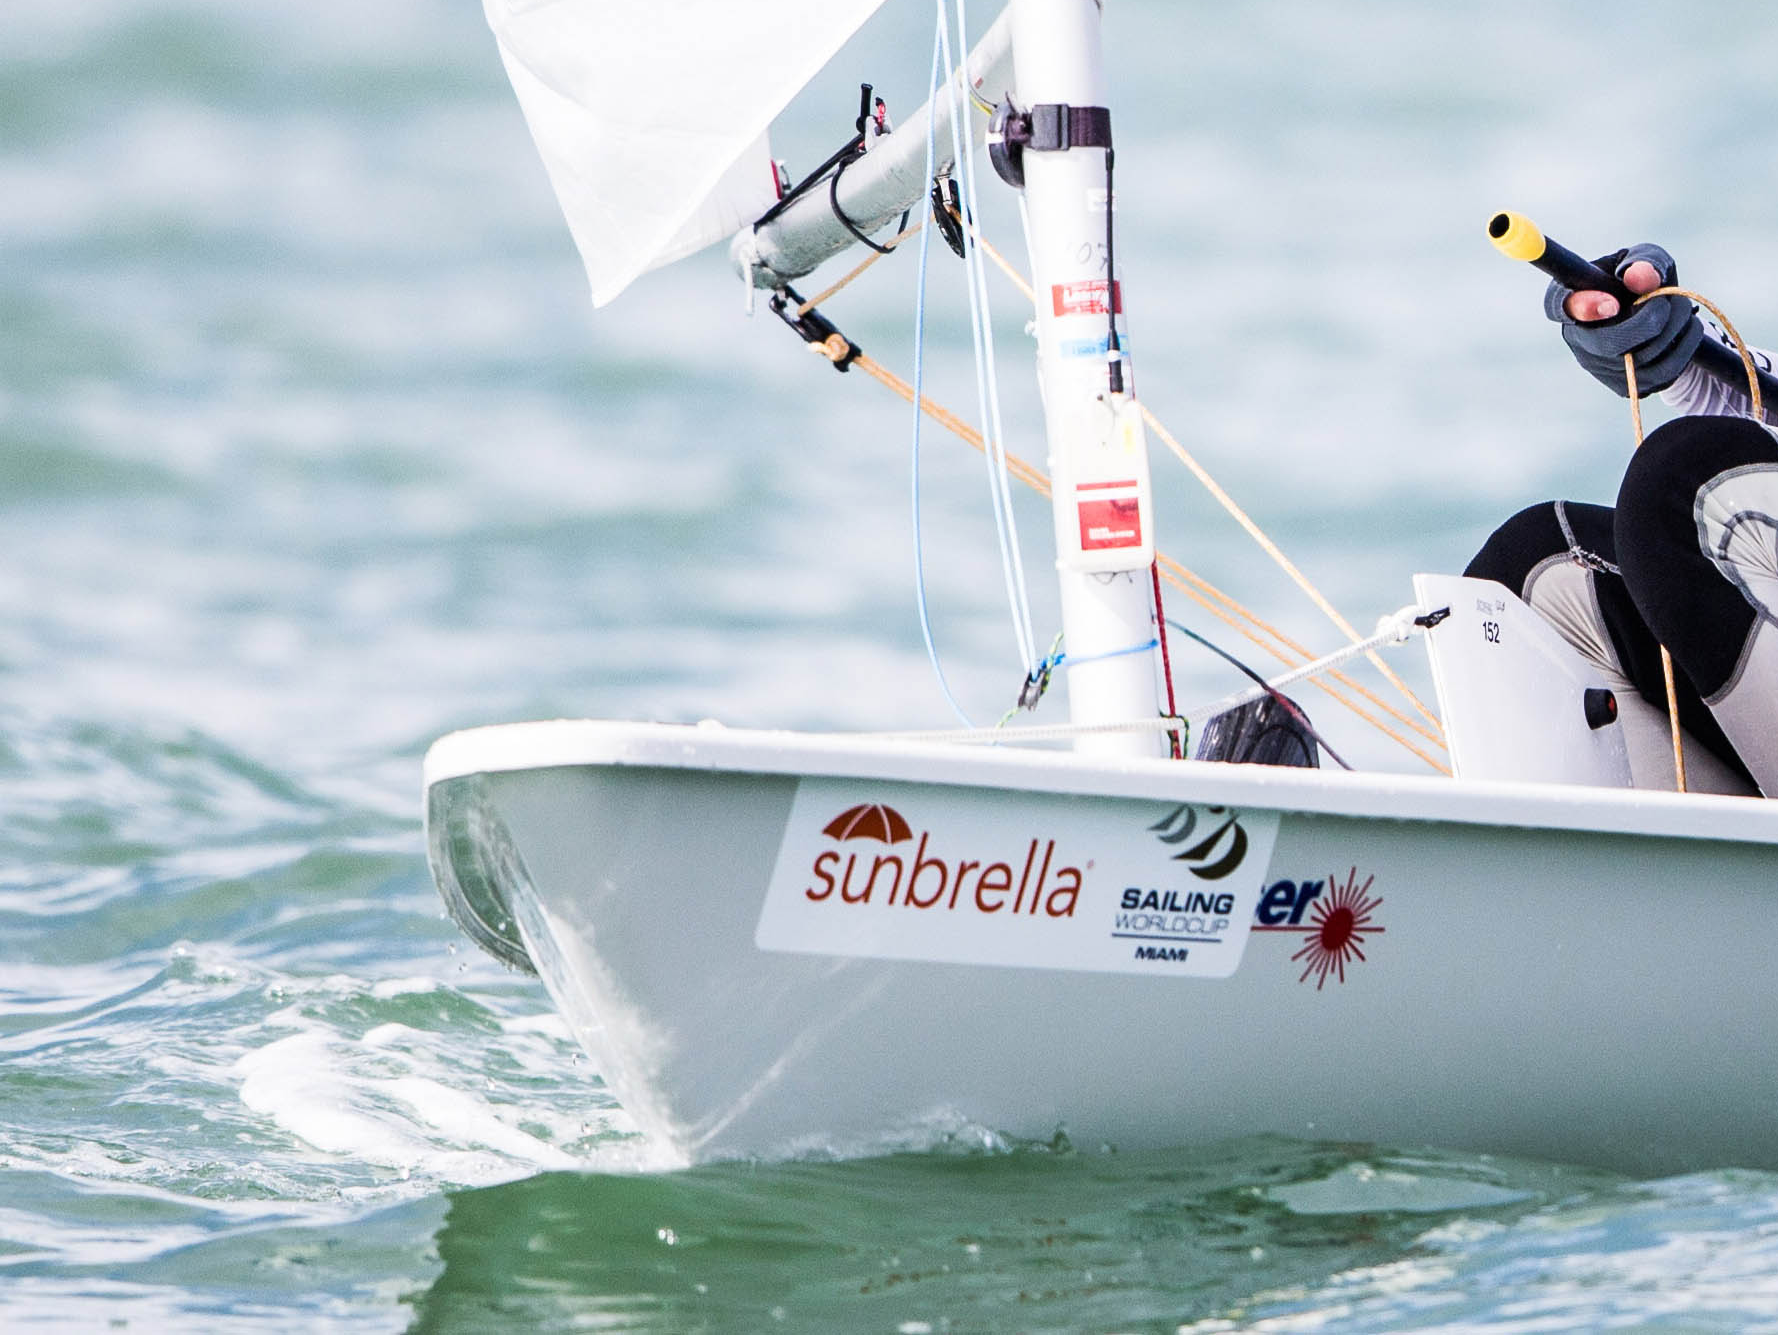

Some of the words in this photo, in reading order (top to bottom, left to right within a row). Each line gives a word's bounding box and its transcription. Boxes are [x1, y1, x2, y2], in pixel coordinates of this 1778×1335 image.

[1482, 620, 1501, 644] 152
[805, 830, 1083, 917] sunbrella
[1120, 887, 1235, 915] SAILING
[1255, 879, 1324, 925] er
[1115, 913, 1230, 935] WORLDCUP
[1134, 946, 1189, 962] MIAMI
